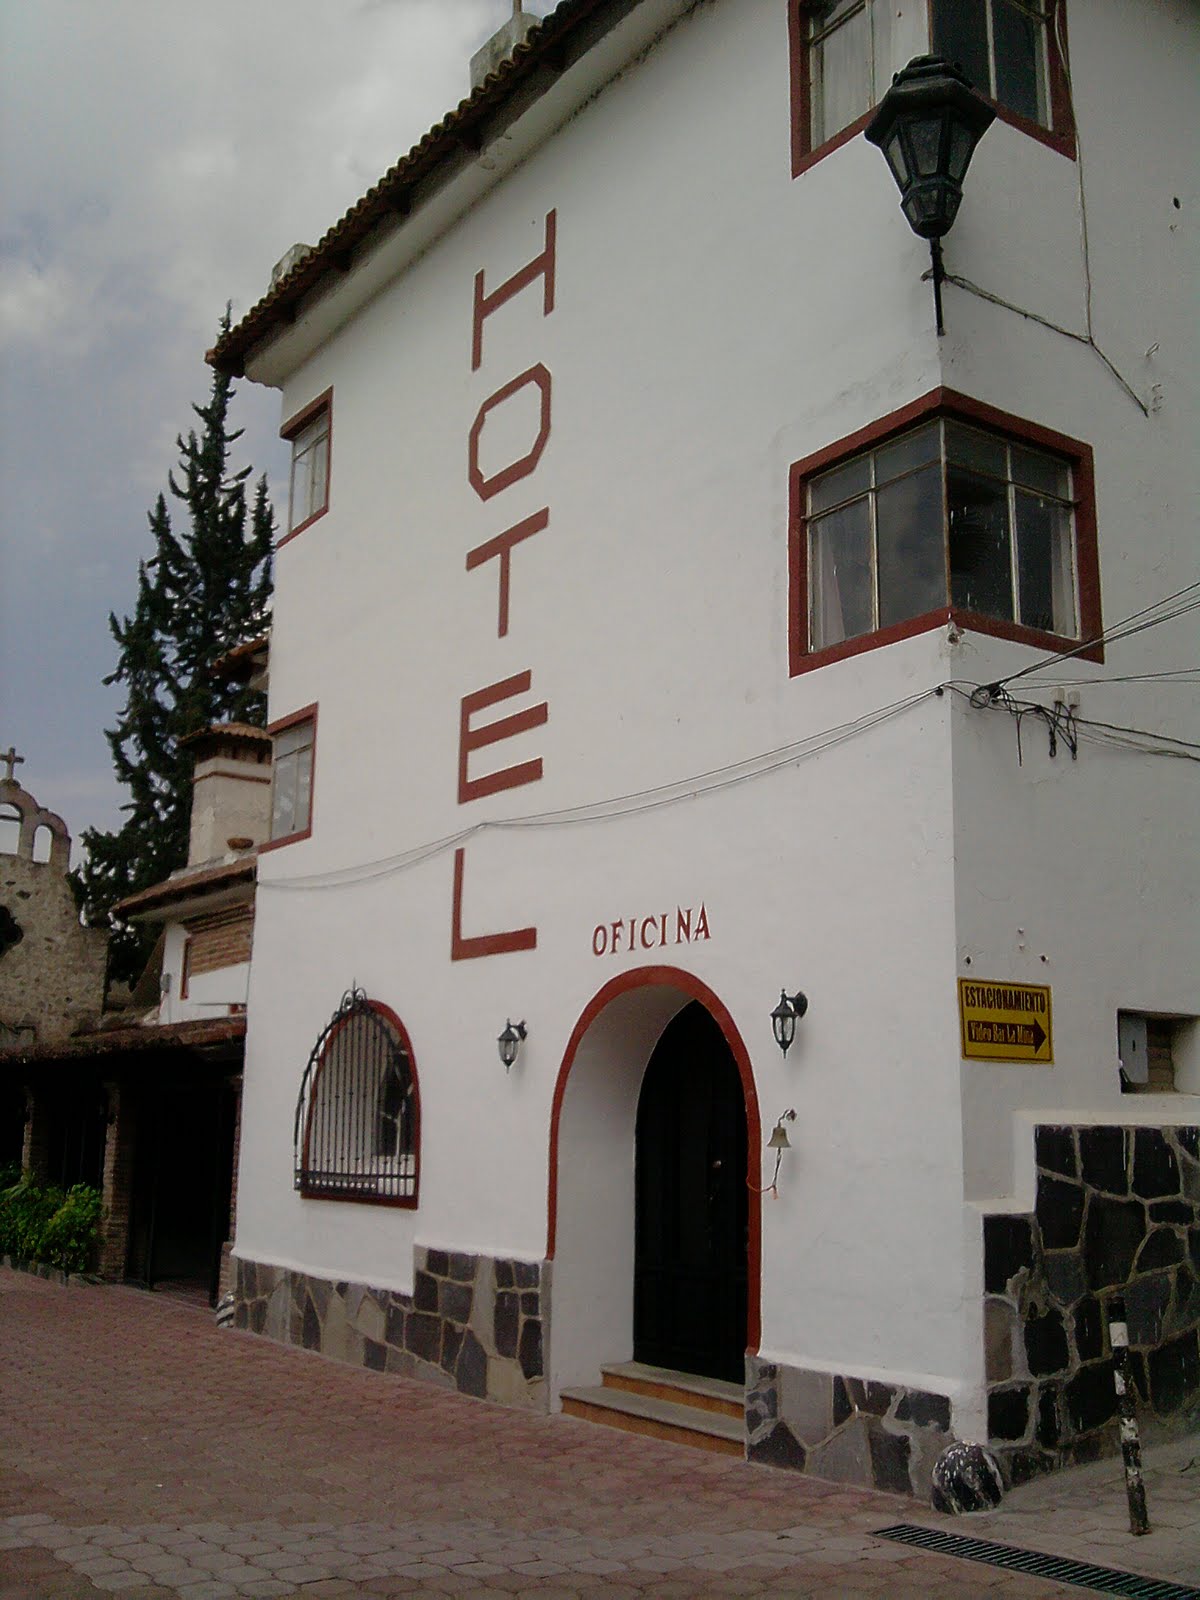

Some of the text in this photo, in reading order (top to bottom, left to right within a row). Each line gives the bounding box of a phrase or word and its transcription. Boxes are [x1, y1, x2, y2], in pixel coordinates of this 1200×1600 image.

[451, 207, 556, 961] HOTEL
[592, 901, 711, 956] OFICINA
[964, 986, 1046, 1013] ESTACIONAMIENTO
[970, 1022, 992, 1041] Video
[1006, 1024, 1016, 1043] La
